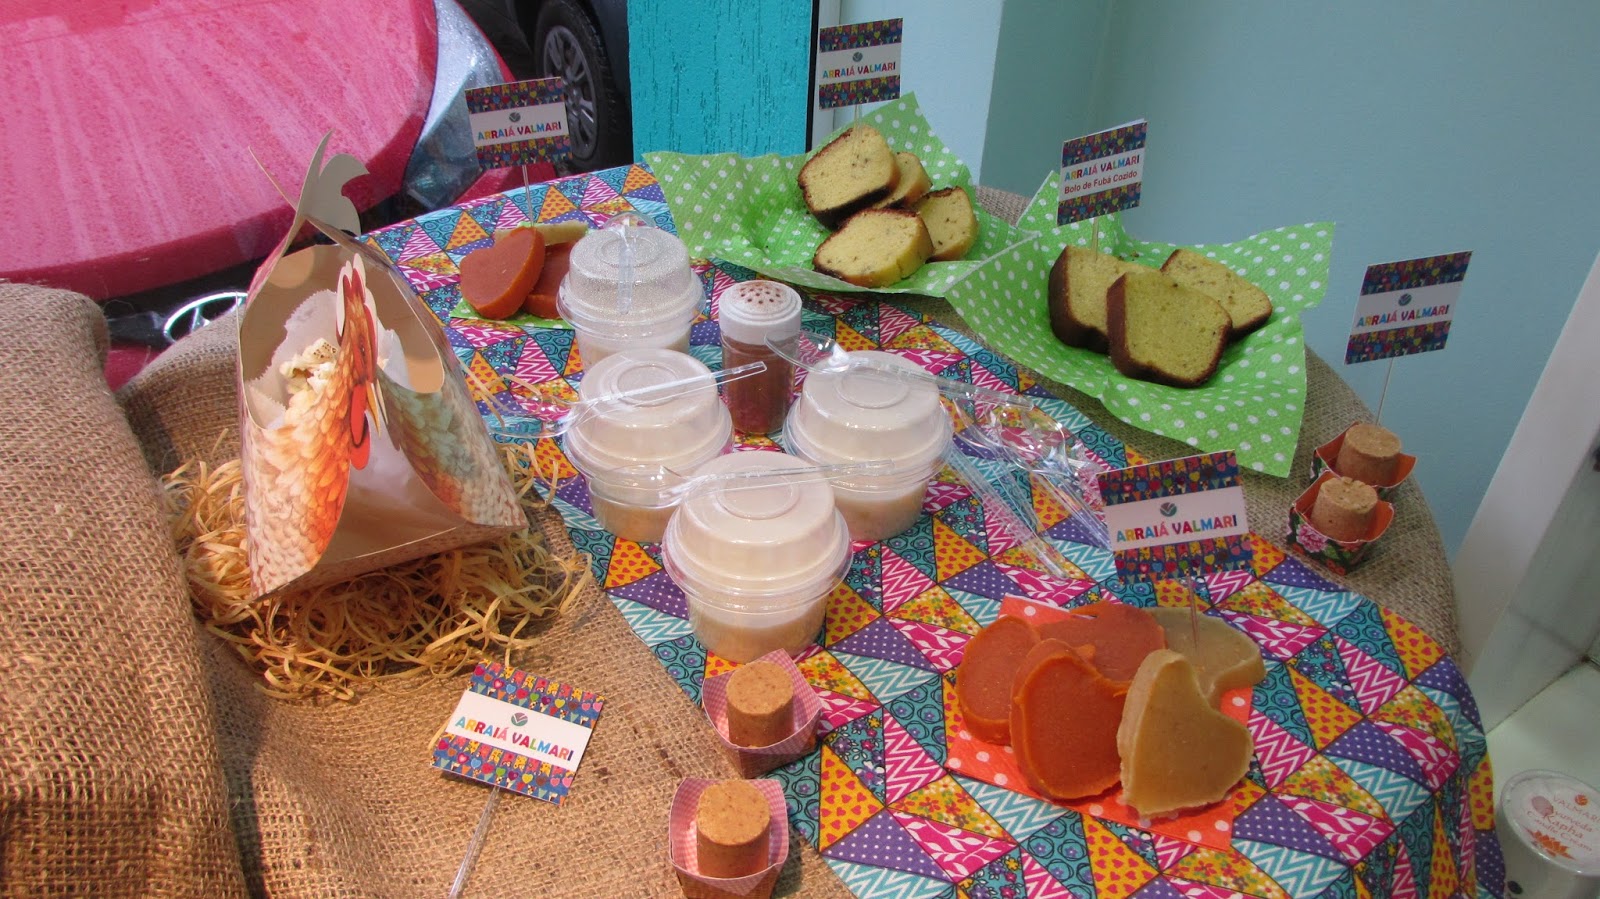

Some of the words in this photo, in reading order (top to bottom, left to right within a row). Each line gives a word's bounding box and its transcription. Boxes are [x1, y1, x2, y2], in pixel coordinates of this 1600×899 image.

[823, 65, 855, 79] ARRAIÁ
[857, 61, 896, 75] VALMARI
[477, 126, 515, 141] ARRAIÁ
[517, 121, 562, 135] VALMARI
[1064, 163, 1098, 182] ARRAIÁ
[1100, 154, 1140, 173] VALMARI
[1064, 184, 1081, 195] Bolo
[1082, 181, 1092, 190] de
[1094, 175, 1112, 187] Fubá
[1113, 170, 1138, 182] Cozido
[1356, 309, 1398, 327] ARRAIÁ
[1401, 304, 1450, 321] VALMARI
[1116, 521, 1169, 543] ARRAIÁ
[1172, 514, 1238, 535] VALMARI
[455, 716, 509, 741] ARRAIÁ
[511, 732, 575, 762] VALMARI
